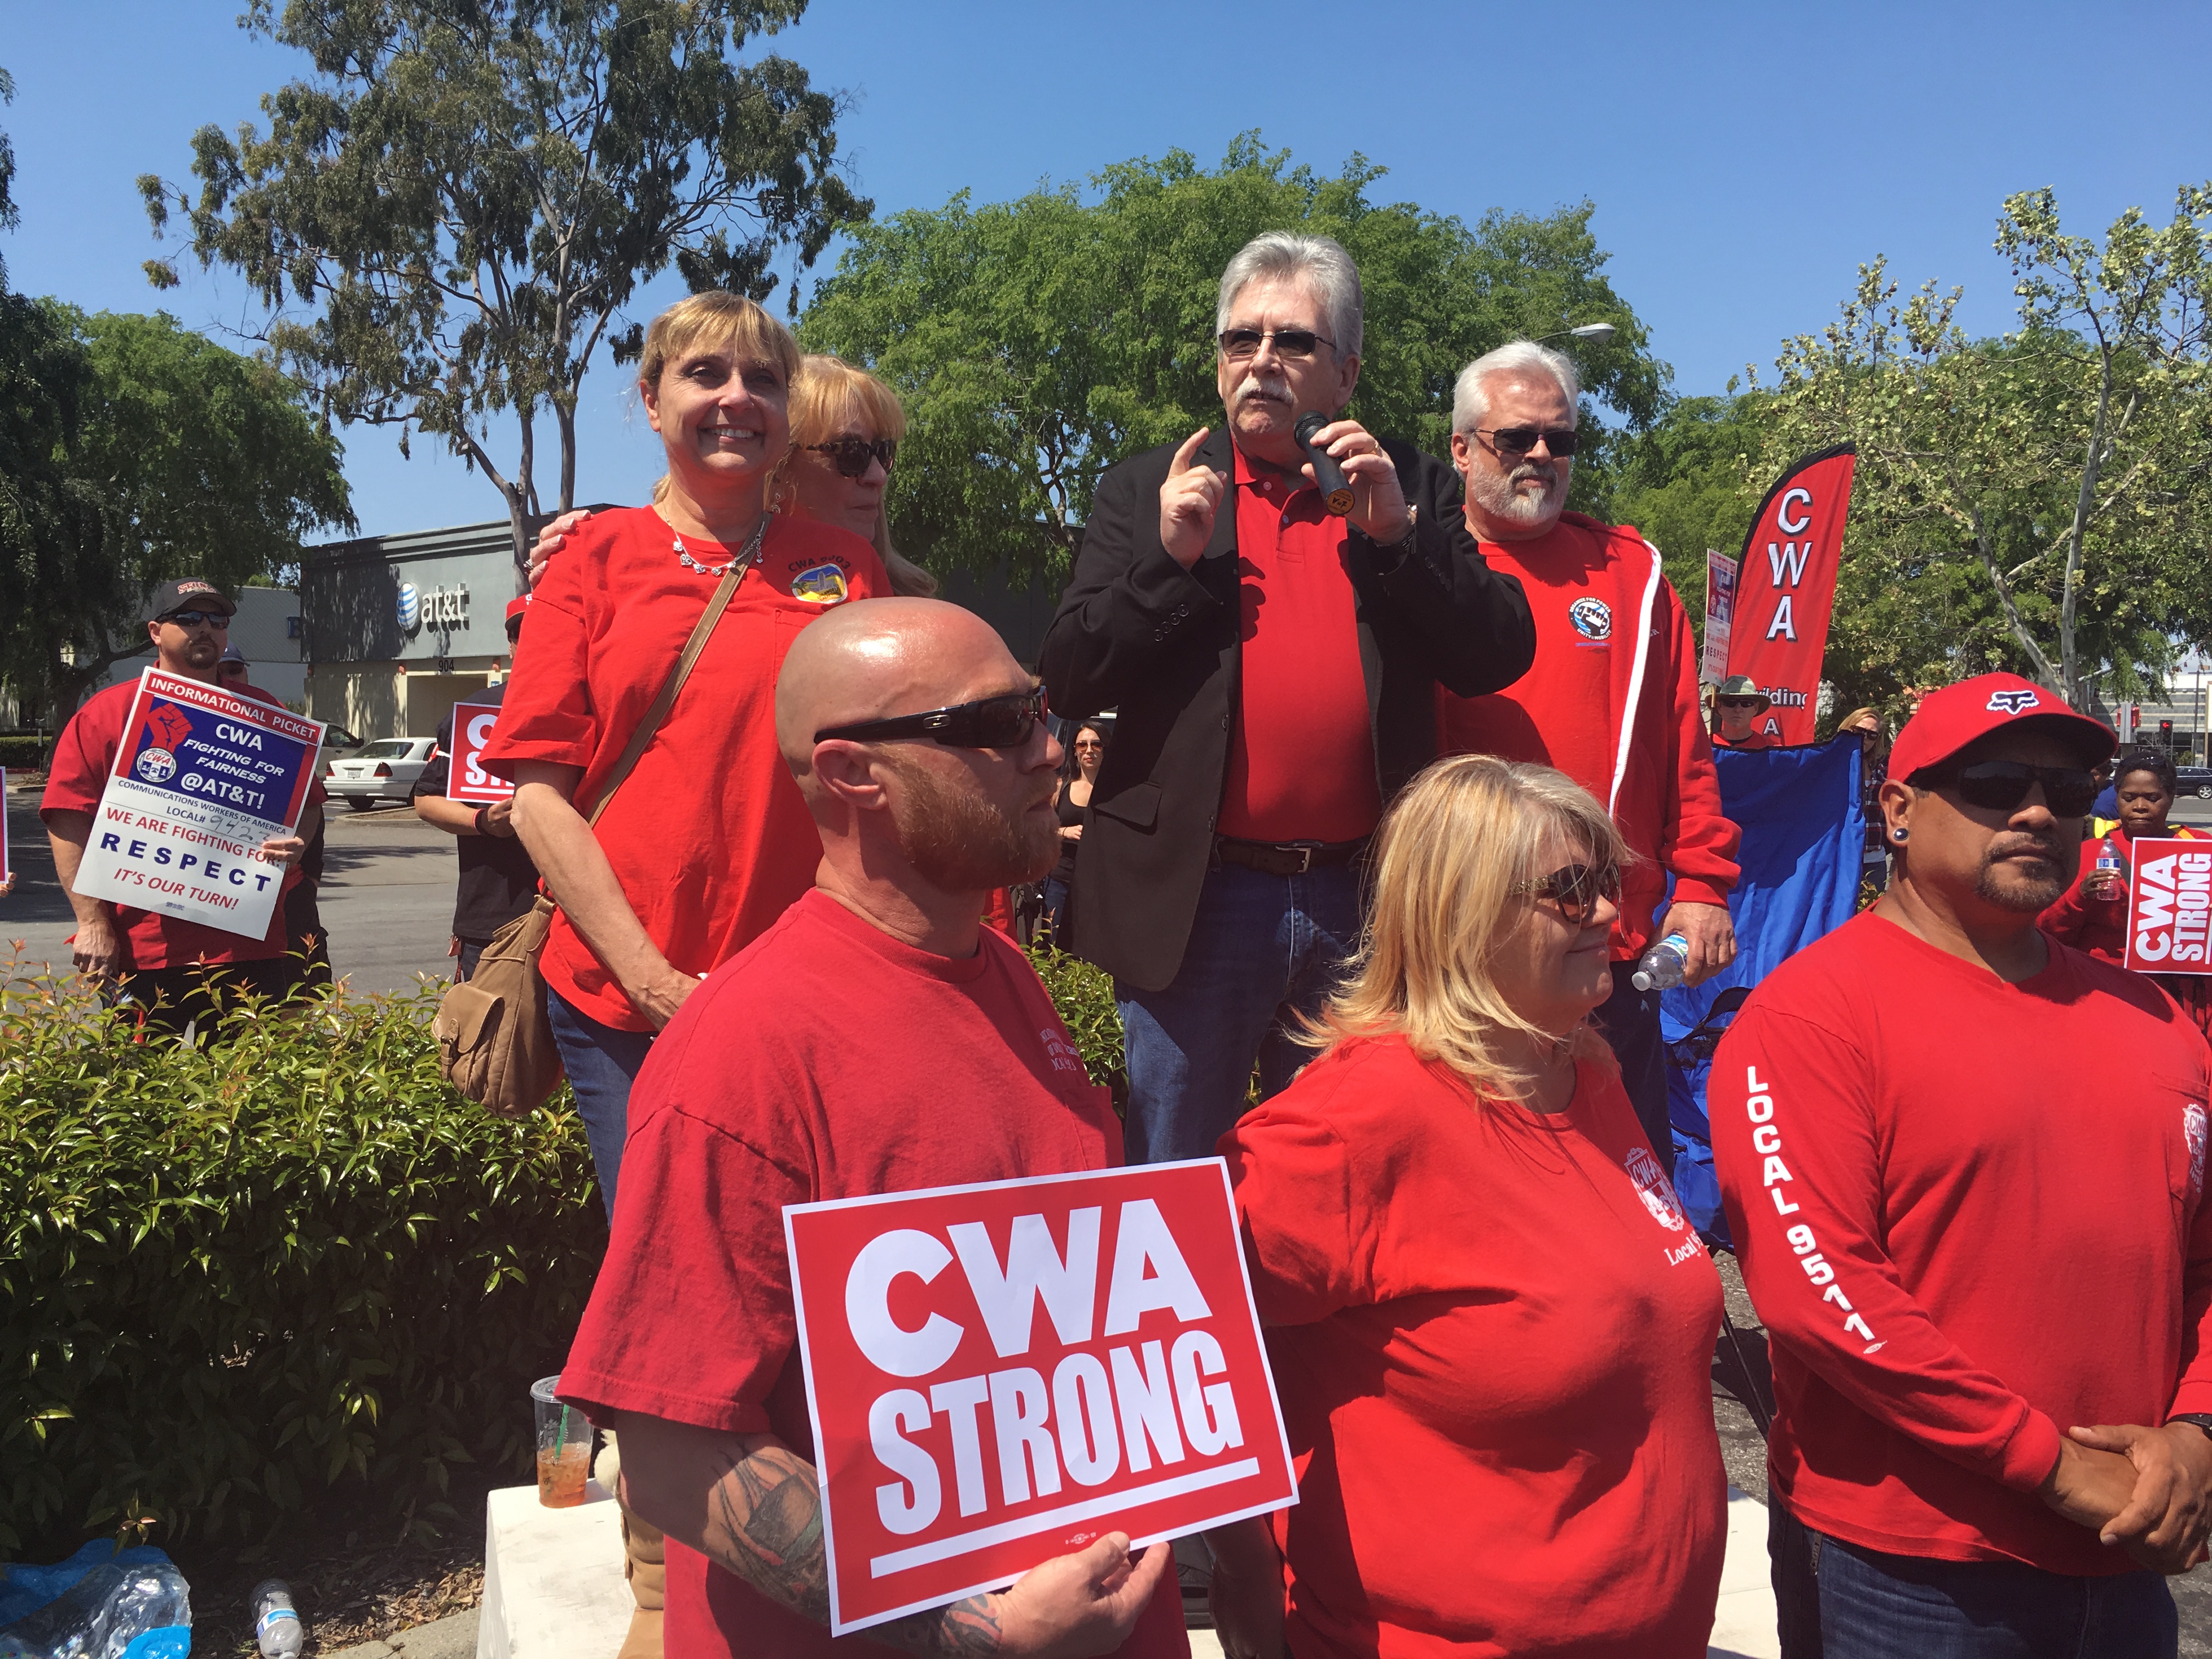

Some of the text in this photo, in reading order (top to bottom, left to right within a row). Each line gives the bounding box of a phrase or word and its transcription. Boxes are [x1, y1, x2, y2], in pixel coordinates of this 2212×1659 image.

[788, 558, 816, 572] CWA
[1766, 488, 1812, 641] CWA
[421, 583, 467, 623] at&t
[1596, 599, 1611, 613] POWER
[438, 659, 454, 672] 904
[1706, 646, 1727, 662] RESPECT
[150, 678, 316, 739] INFORMATIONAL PICKET
[216, 723, 263, 752] CWA
[145, 752, 171, 766] CWA
[183, 738, 285, 776] FIGHTING FOR
[195, 756, 267, 785] FAIRNESS
[118, 780, 198, 808] COMMUNICATIONS
[201, 802, 239, 820] WORKERS
[251, 819, 286, 836] AMERICA
[180, 772, 266, 810] @AT&T!
[106, 807, 133, 825] WE
[135, 816, 169, 834] ARE
[171, 825, 244, 856] FIGHTING
[166, 805, 206, 823] LOCAL#
[100, 832, 272, 892] RESPECT
[148, 877, 185, 896] OUR
[190, 887, 239, 910] TURN!
[2135, 854, 2177, 961] CWA
[2171, 853, 2211, 961] STRONG
[1747, 1066, 1875, 1341] LOCAL 9511
[1664, 1237, 1698, 1266] Local
[845, 1198, 1213, 1377] CWA
[868, 1330, 1244, 1534] STRONG
